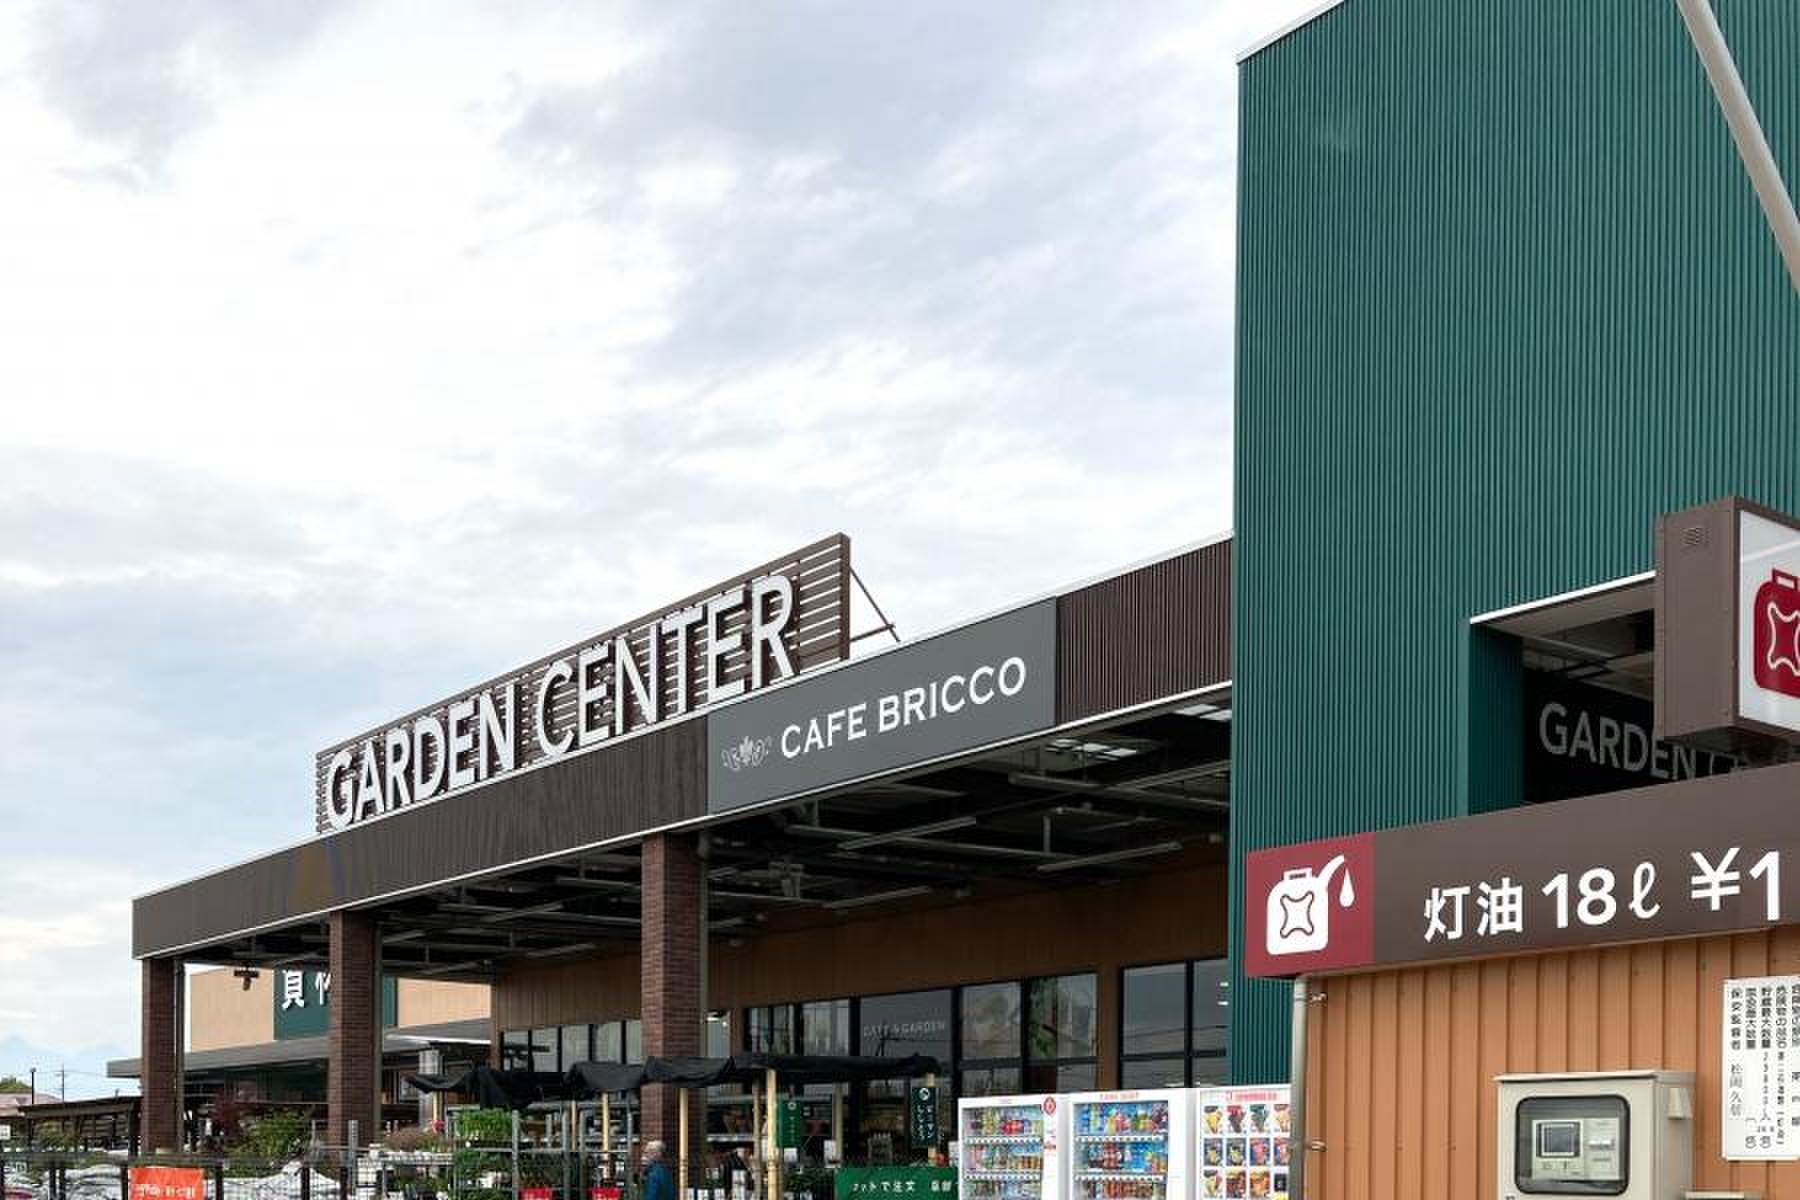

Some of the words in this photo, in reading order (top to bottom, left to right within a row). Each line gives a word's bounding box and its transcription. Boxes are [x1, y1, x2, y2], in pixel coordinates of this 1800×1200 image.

[324, 684, 517, 830] GARDEN
[534, 575, 795, 758] CENTER
[780, 703, 867, 759] CAFE
[878, 656, 1027, 734] BRICCO
[1539, 701, 1697, 781] GARDEN
[1423, 876, 1525, 943] 灯油
